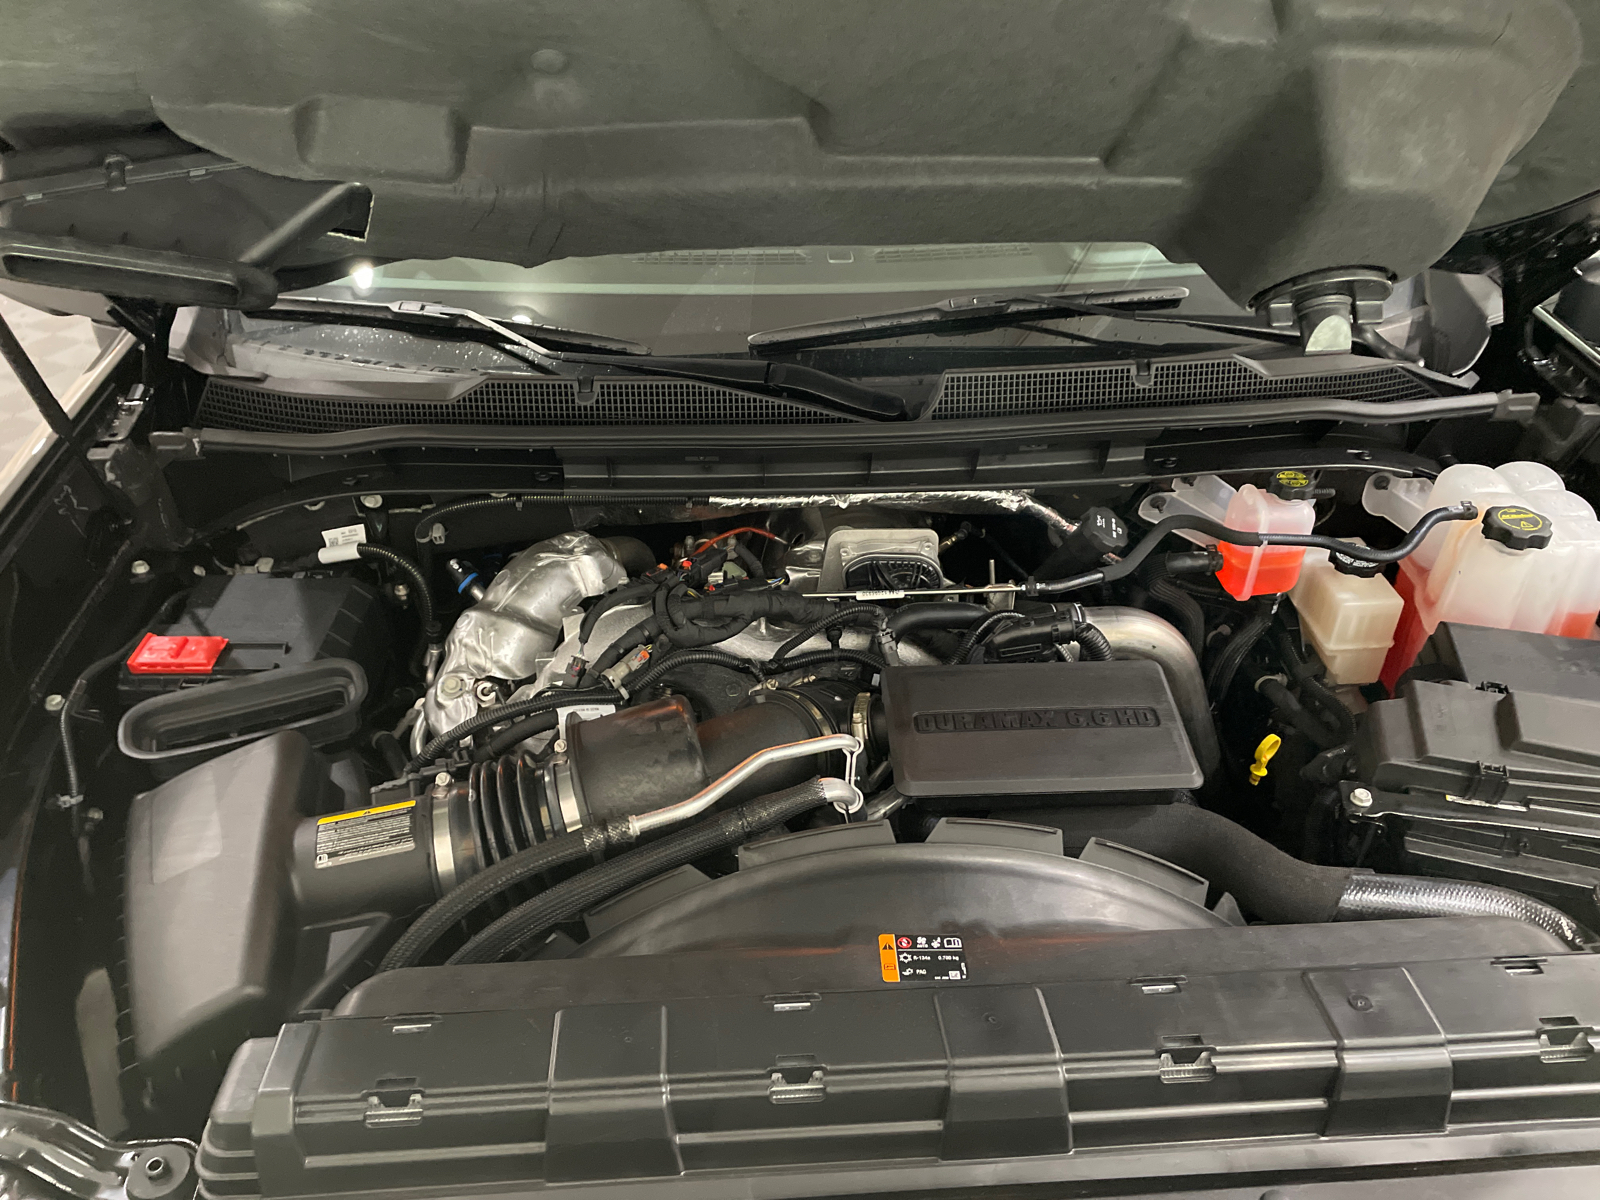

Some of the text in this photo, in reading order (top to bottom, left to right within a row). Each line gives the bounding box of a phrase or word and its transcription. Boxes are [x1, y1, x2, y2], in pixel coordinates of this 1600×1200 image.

[917, 708, 1156, 732] DURAMAX 6.6 HD
